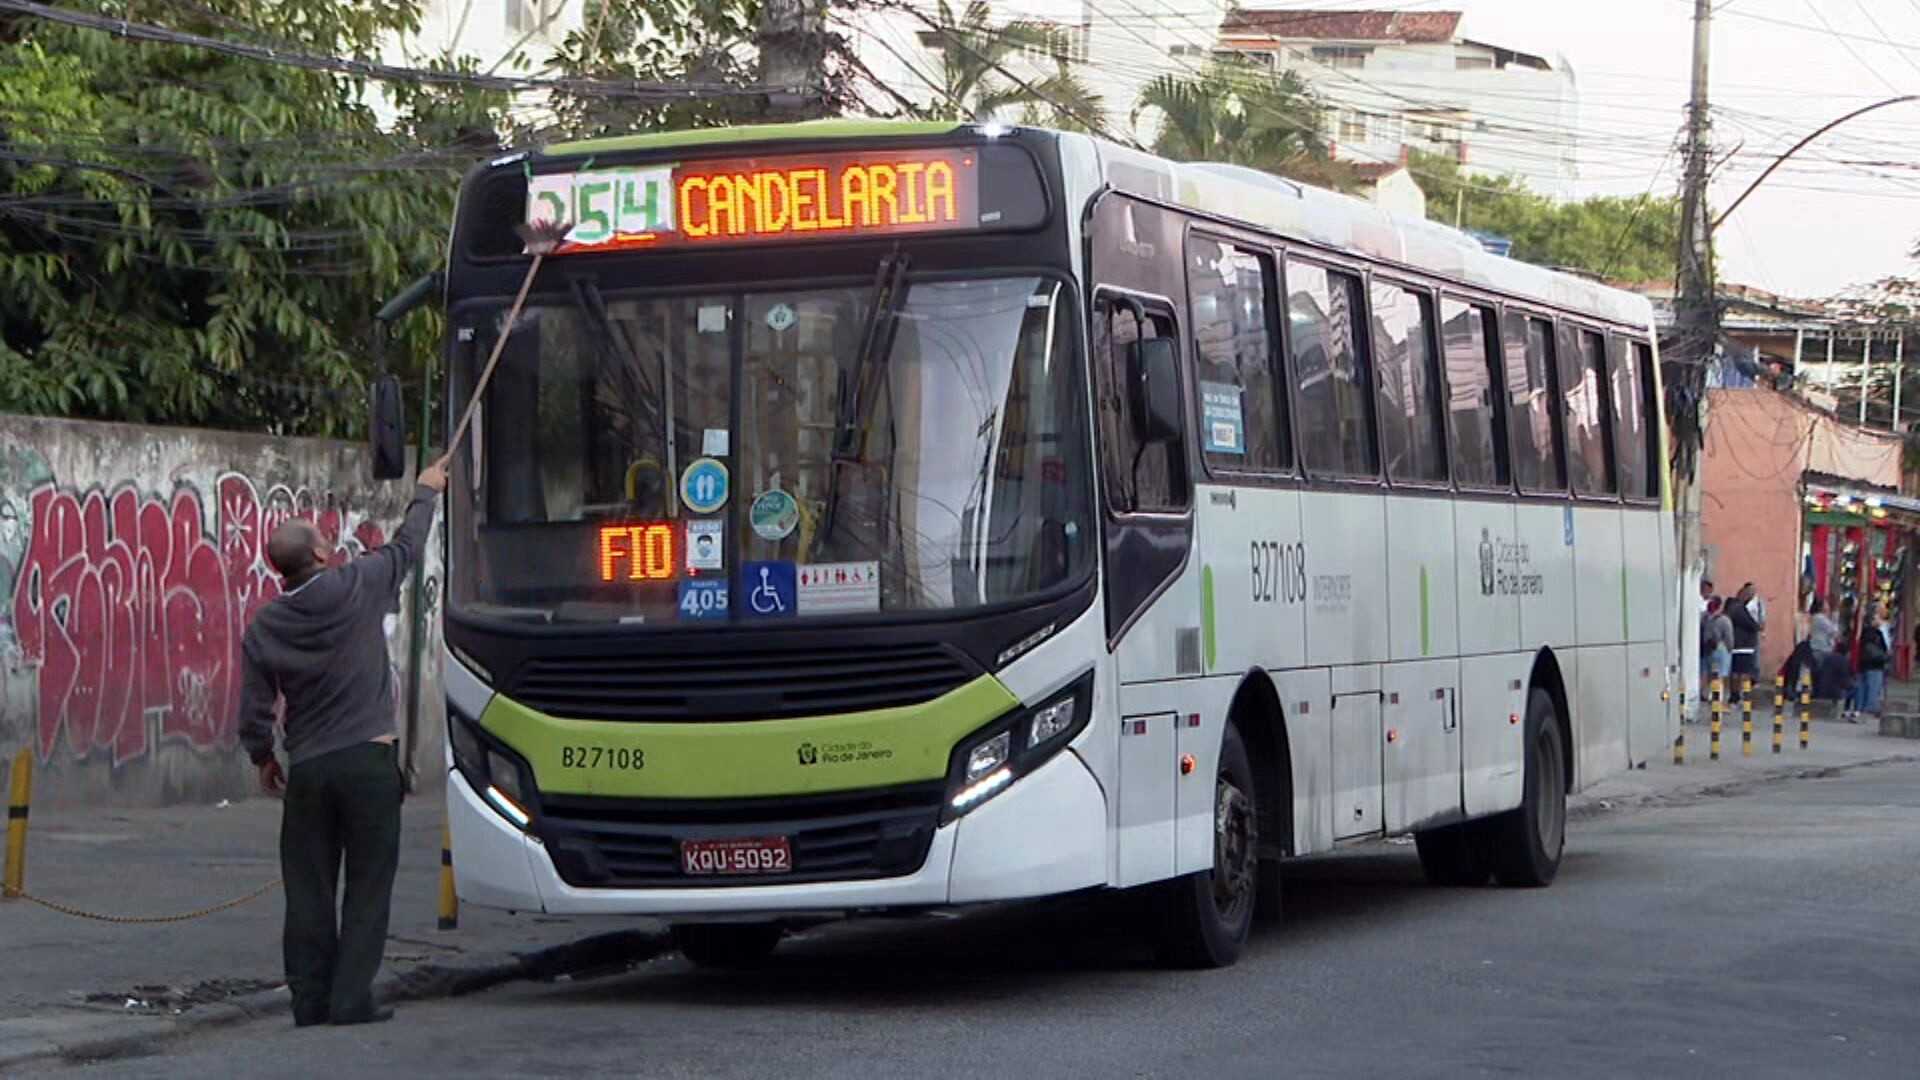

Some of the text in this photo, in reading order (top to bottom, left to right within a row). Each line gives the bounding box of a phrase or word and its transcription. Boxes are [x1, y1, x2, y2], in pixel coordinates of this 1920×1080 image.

[680, 160, 956, 237] CANDELARIA
[1251, 541, 1306, 603] B27108
[680, 589, 728, 617] 4,05
[562, 746, 645, 770] B27108
